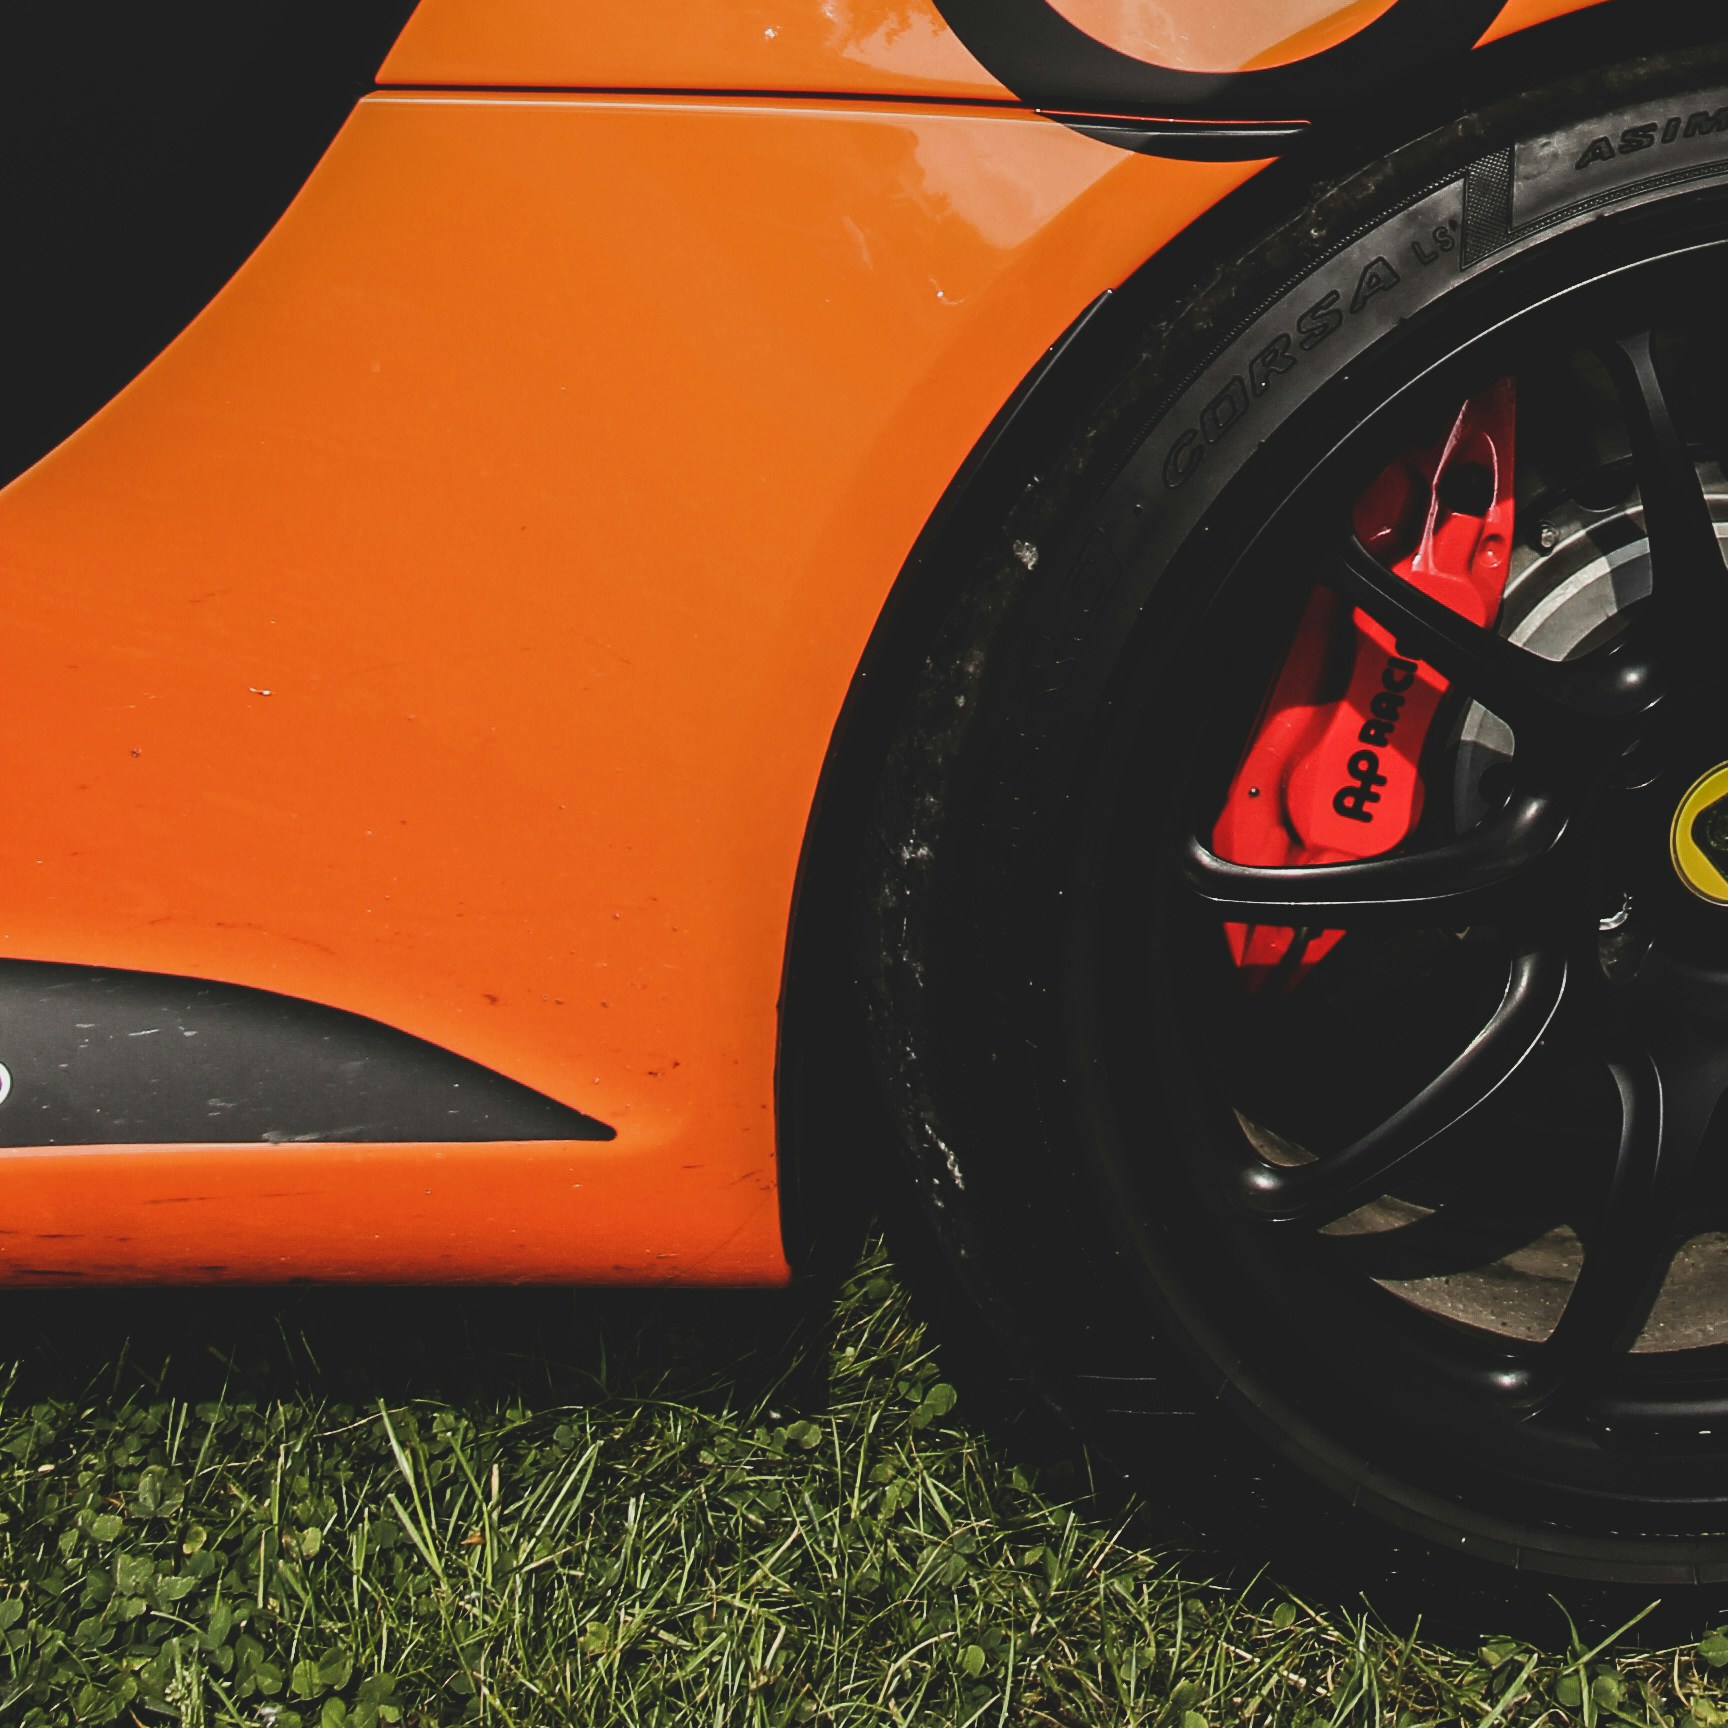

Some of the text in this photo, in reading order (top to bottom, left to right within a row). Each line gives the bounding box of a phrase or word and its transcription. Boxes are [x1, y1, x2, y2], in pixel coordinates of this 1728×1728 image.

[1163, 255, 1401, 489] CORSA
[1333, 641, 1418, 823] AP RACI
